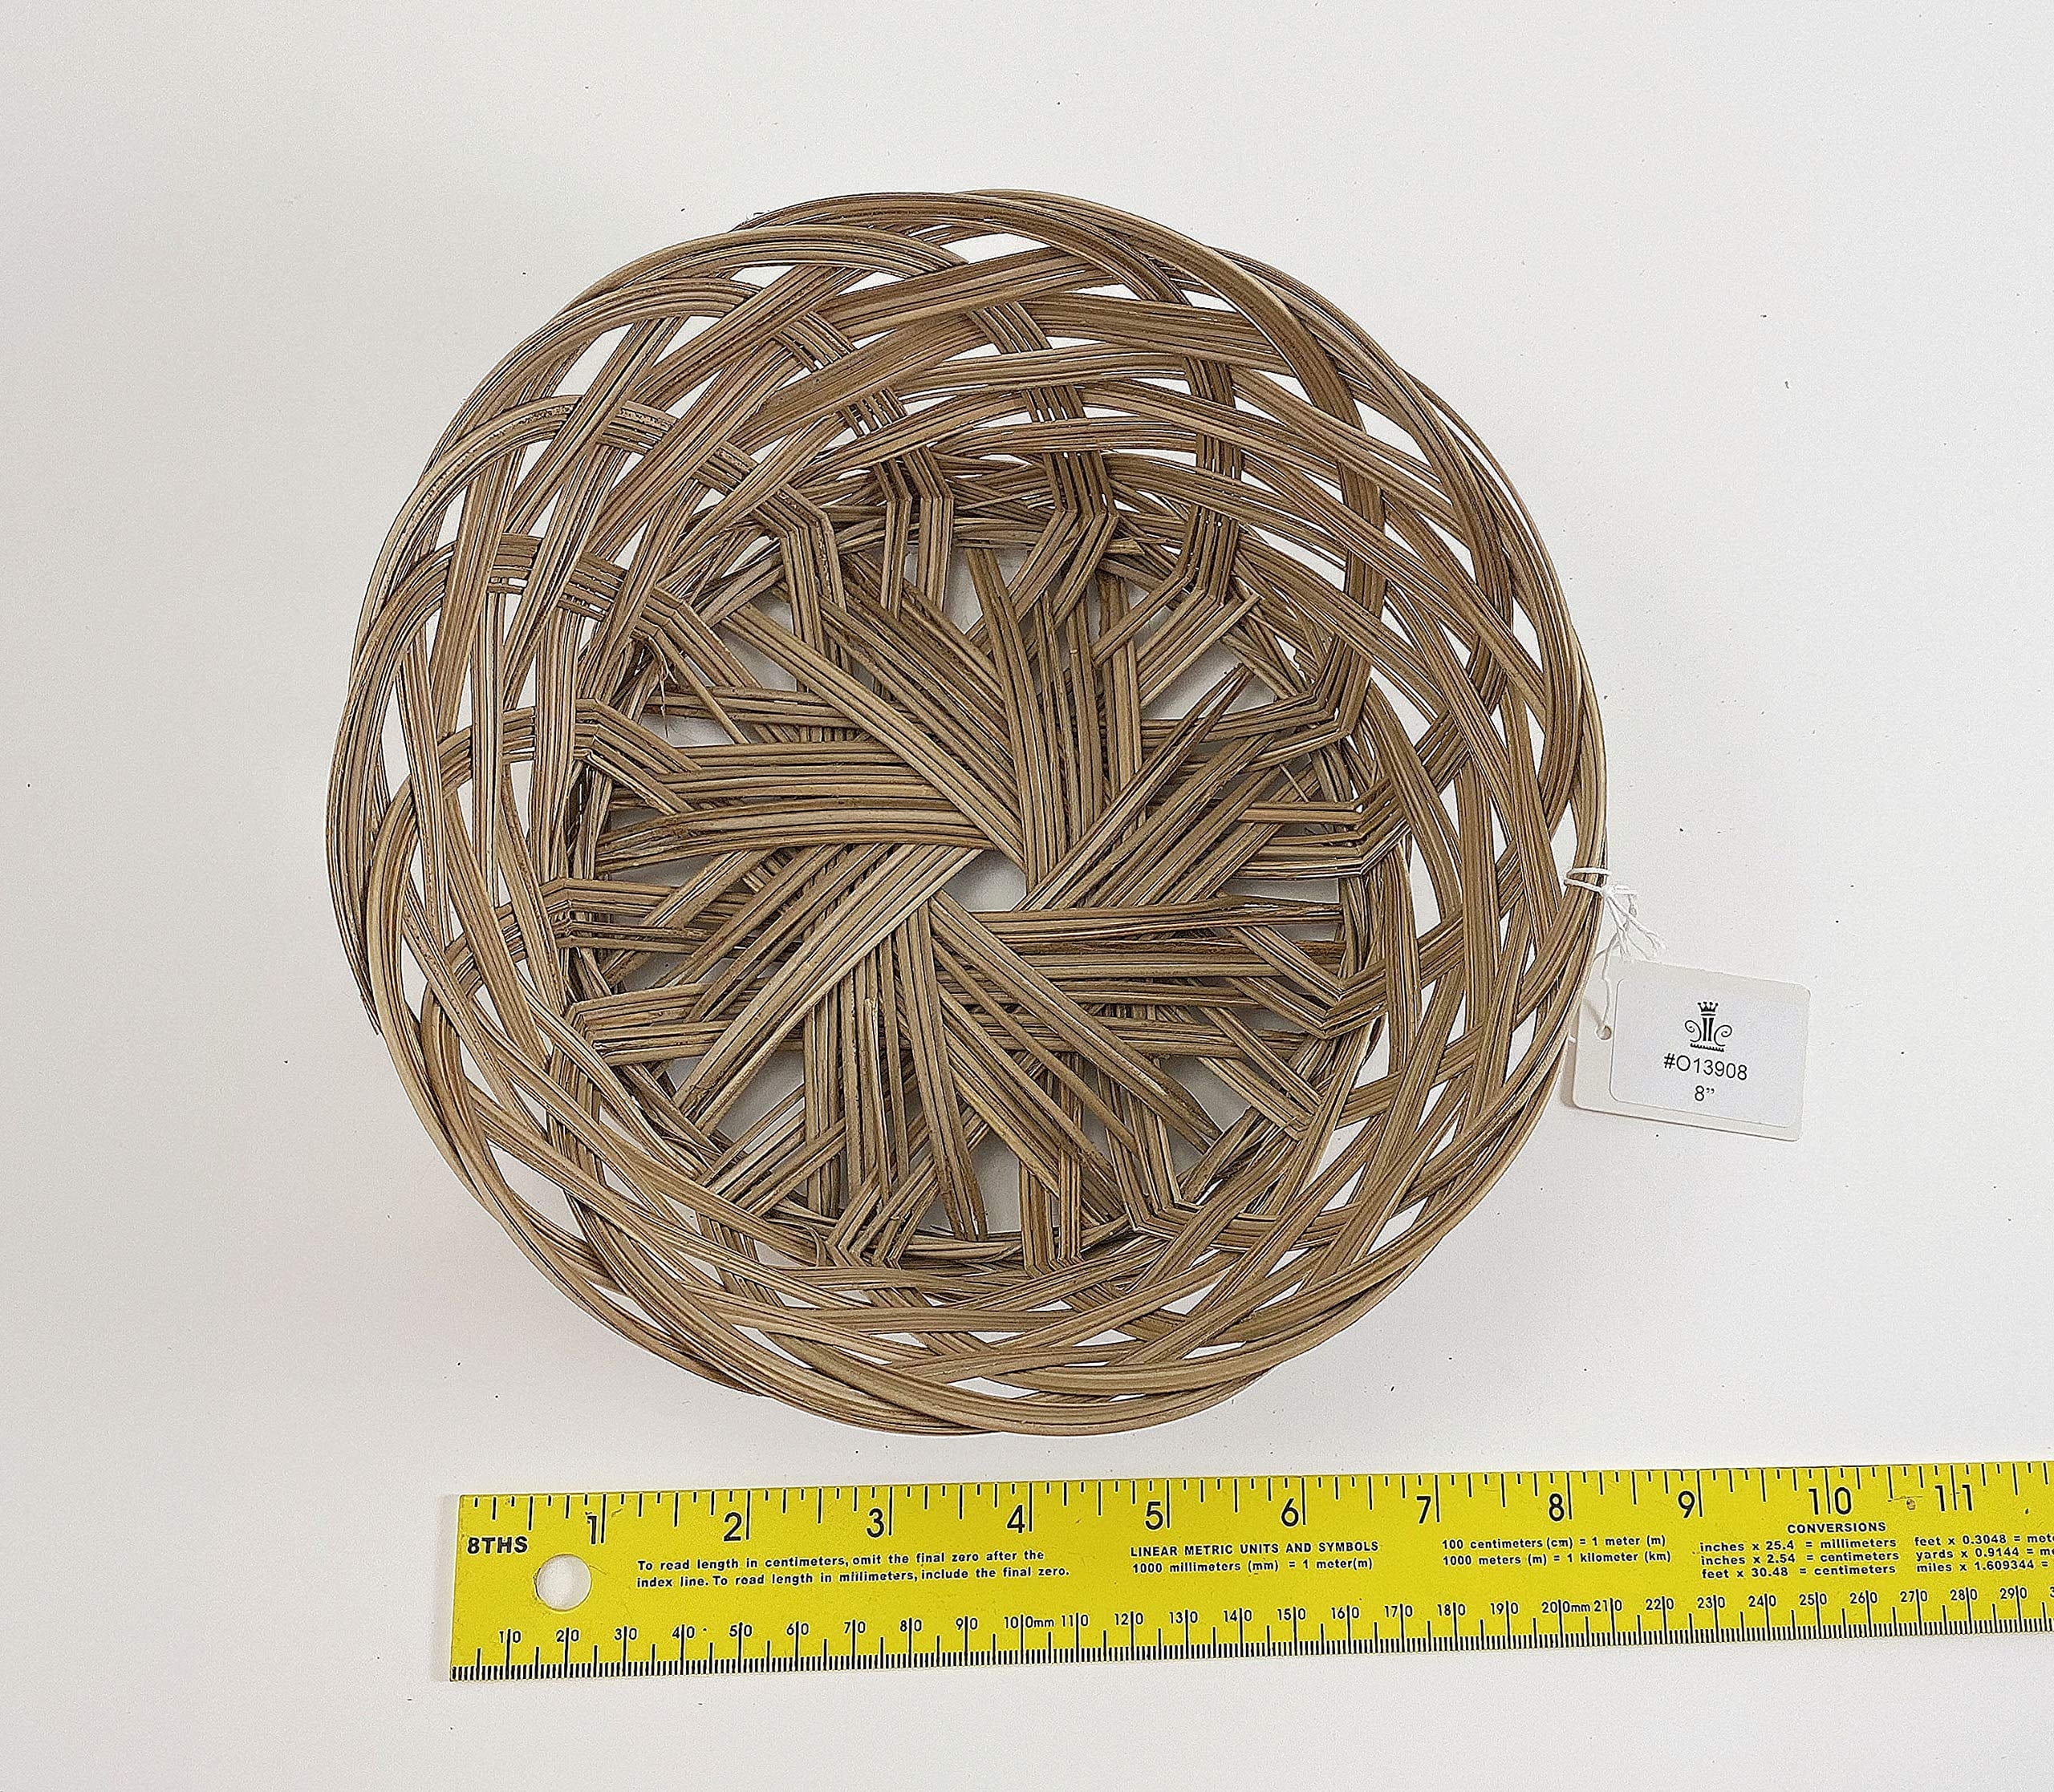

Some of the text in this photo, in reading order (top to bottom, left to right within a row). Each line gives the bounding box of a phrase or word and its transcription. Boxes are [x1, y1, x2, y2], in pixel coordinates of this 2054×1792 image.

[589, 1485, 1972, 1544] 1 2 3 4 5 6 7 8 9 10 11
[1787, 1522, 1886, 1534] CONVERSIONS
[467, 1535, 528, 1555] 8THS
[1442, 1539, 1463, 1550] 100
[1470, 1538, 1543, 1549] centimeters
[1546, 1536, 1573, 1551] (cm)
[1591, 1536, 1597, 1547] 1
[1605, 1536, 1641, 1546] meter
[1646, 1535, 1666, 1548] (m)
[1699, 1542, 1745, 1552] inches
[1765, 1539, 1794, 1551] 25.4
[1821, 1539, 1897, 1549] millimeters
[1914, 1536, 1942, 1547] feet
[1947, 1538, 1955, 1546] x
[1962, 1534, 2007, 1545] 0.3048
[2027, 1533, 2054, 1543] met
[1131, 1541, 1378, 1558] LINEAR METRIC UNITS AND SYMBOLS
[1915, 1549, 1954, 1563] yards
[1960, 1550, 1969, 1559] x
[1975, 1547, 2019, 1558] 0.9144
[637, 1549, 1044, 1571] To read length in centimeters, omit the final zero after the
[1132, 1563, 1163, 1574] 1000
[1169, 1561, 1241, 1573] millimeters
[1248, 1559, 1279, 1573] (mm)
[1302, 1559, 1309, 1569] 1
[1443, 1555, 1471, 1566] 1000
[1478, 1555, 1521, 1565] meters
[1528, 1553, 1547, 1567] (m)
[1567, 1553, 1573, 1563] 1
[1580, 1551, 1638, 1563] kilometer
[1644, 1550, 1670, 1564] (km)
[1700, 1555, 1746, 1566] inches
[1752, 1556, 1761, 1564] x
[1767, 1553, 1796, 1564] 2.54
[1820, 1551, 1899, 1563] centimeters
[1917, 1562, 1952, 1573] miles
[1959, 1563, 1967, 1571] x
[1974, 1559, 2034, 1571] 1.609344
[637, 1576, 673, 1587] index
[680, 1575, 708, 1587] line.
[712, 1575, 728, 1586] To
[772, 1572, 813, 1587] length
[820, 1571, 832, 1583] in
[839, 1571, 918, 1583] millimeters,
[921, 1568, 968, 1580] include
[975, 1567, 997, 1579] the
[1002, 1566, 1031, 1577] final
[1038, 1567, 1070, 1576] zero.
[1702, 1568, 1729, 1579] feet
[1736, 1570, 1744, 1578] x
[1751, 1567, 1788, 1578] 30.48
[1814, 1564, 1896, 1575] centimeters
[499, 1631, 521, 1643] 10
[557, 1630, 579, 1643] 20
[614, 1628, 637, 1640] 30
[672, 1626, 695, 1640] 40
[729, 1624, 752, 1637] 50
[786, 1623, 809, 1636] 60
[844, 1621, 865, 1634] 70
[900, 1619, 922, 1632] 80
[956, 1618, 977, 1630] 90
[1061, 1613, 1088, 1626] 110
[1114, 1612, 1143, 1625] 120
[1169, 1611, 1198, 1624] 130
[1224, 1608, 1252, 1623] 140
[1277, 1608, 1305, 1621] 150
[1331, 1606, 1359, 1620] 160
[1385, 1605, 1412, 1618] 170
[1438, 1603, 1465, 1616] 180
[1491, 1602, 1518, 1615] 190
[1594, 1599, 1622, 1612] 210
[1646, 1597, 1674, 1611] 220
[1697, 1595, 1725, 1608] 230
[1748, 1595, 1776, 1608] 240
[1800, 1592, 1827, 1606] 250
[1849, 1591, 1877, 1604] 260
[1900, 1590, 1927, 1603] 270
[1950, 1588, 1977, 1601] 280
[1999, 1587, 2027, 1599] 290
